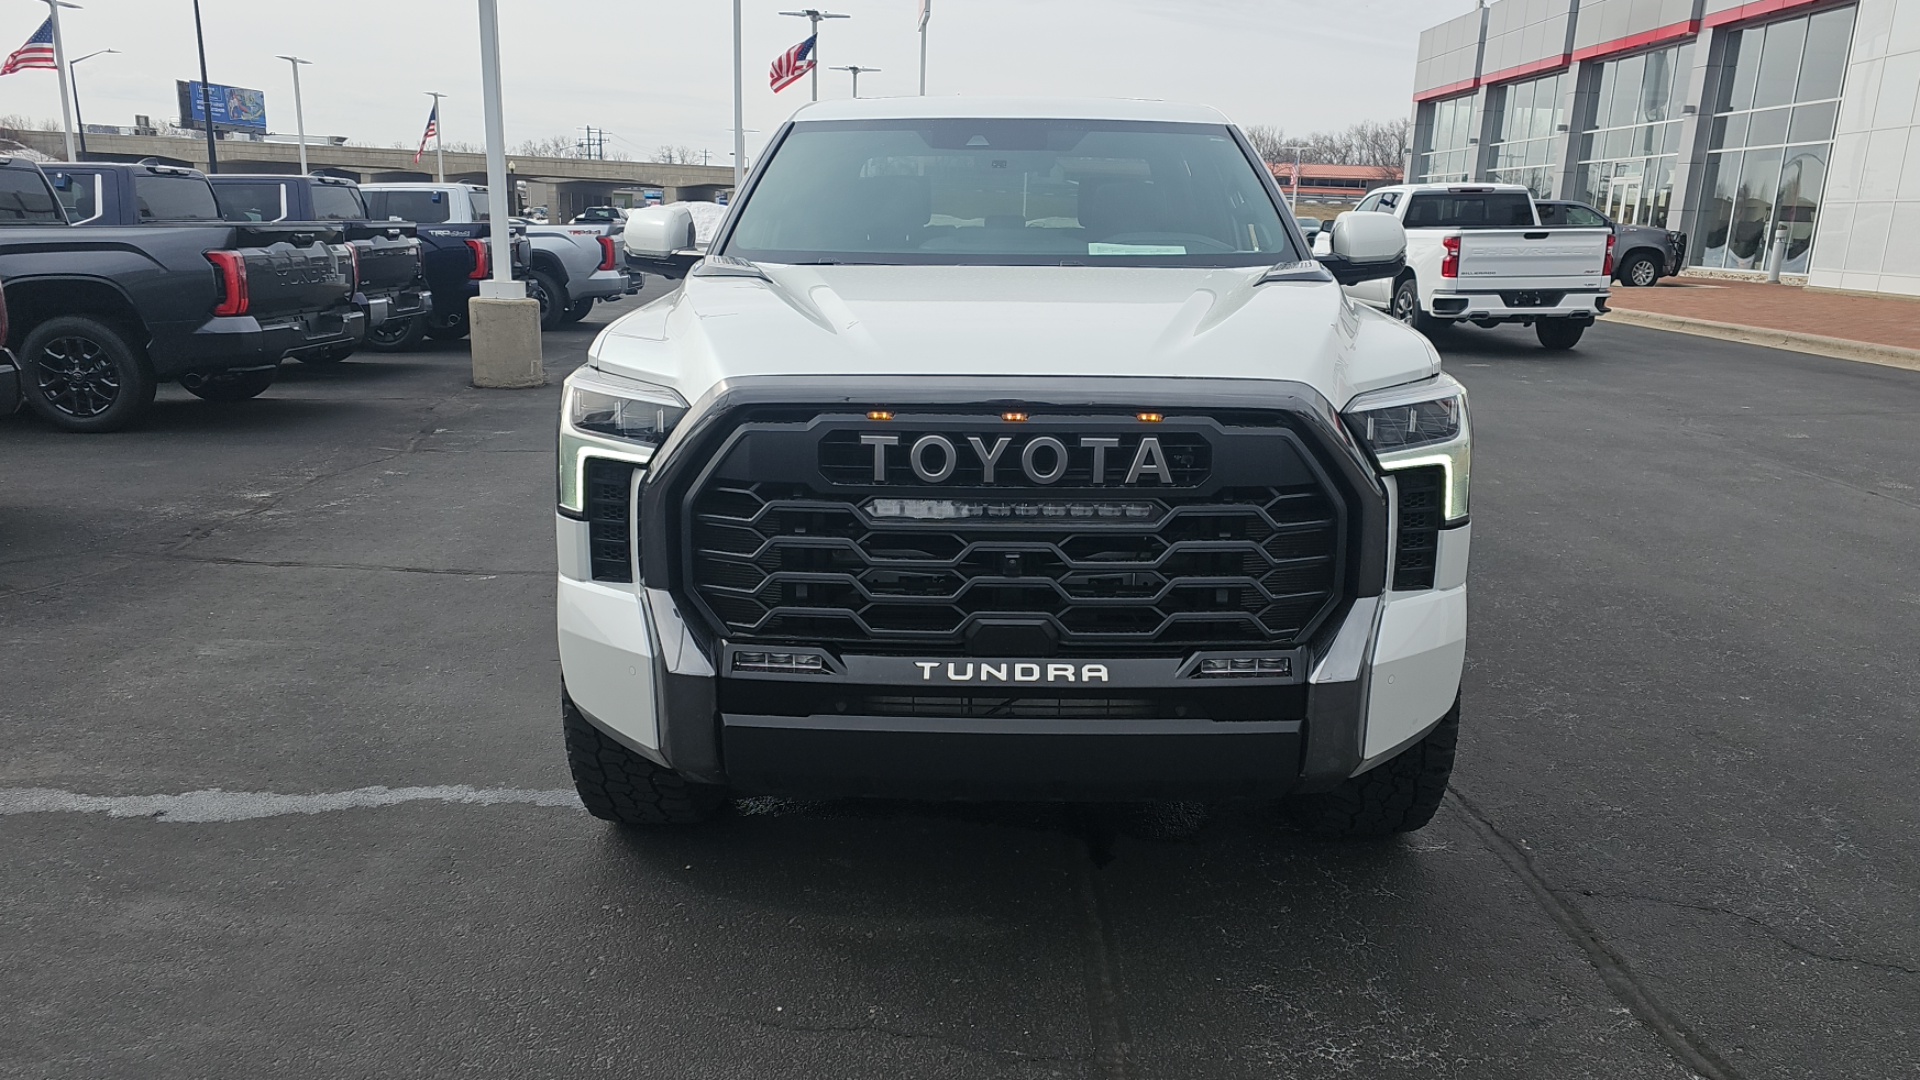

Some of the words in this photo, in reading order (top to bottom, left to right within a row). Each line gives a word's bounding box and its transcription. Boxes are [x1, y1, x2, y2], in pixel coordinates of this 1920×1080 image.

[1471, 246, 1598, 256] CHEVROLET
[860, 434, 1173, 484] TOYOTA
[914, 661, 1109, 682] TUNDRA
